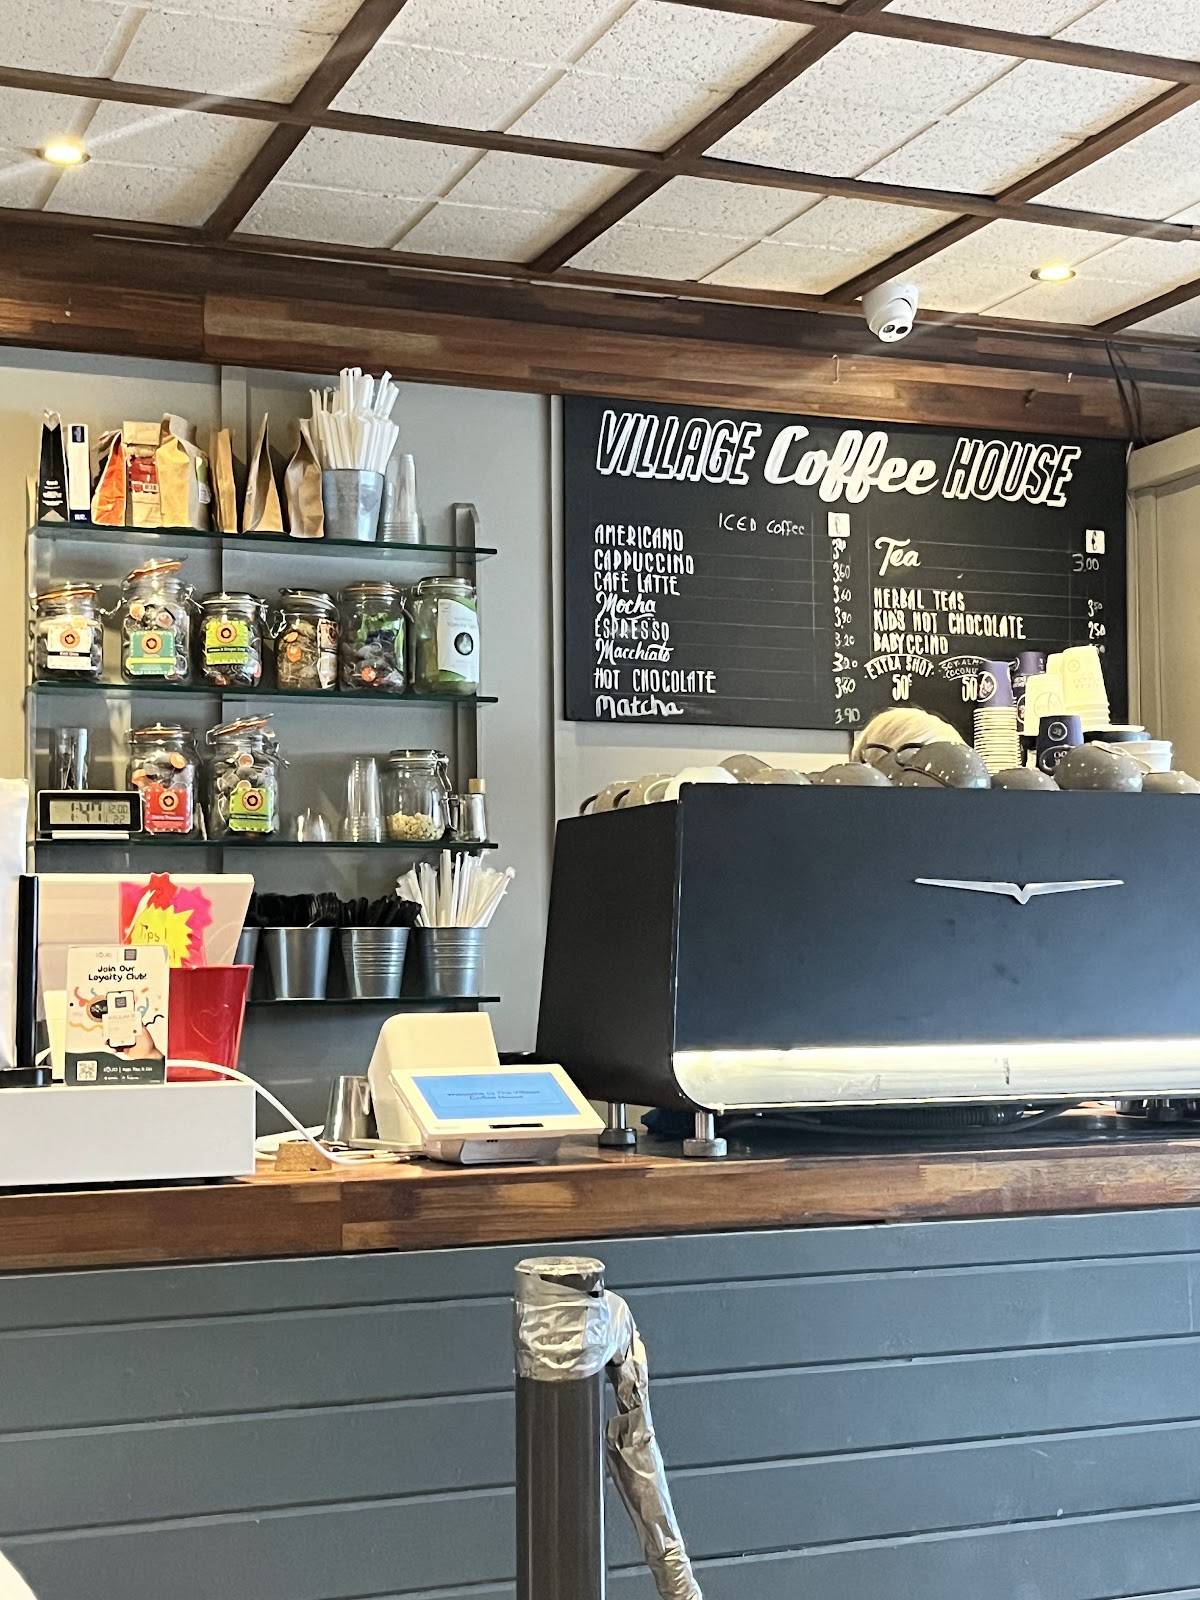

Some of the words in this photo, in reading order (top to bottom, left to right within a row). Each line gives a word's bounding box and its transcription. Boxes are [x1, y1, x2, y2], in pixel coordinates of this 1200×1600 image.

[596, 410, 762, 485] VILLAGE
[763, 426, 939, 503] Coffee
[942, 437, 1081, 507] HOUSE
[719, 512, 757, 532] ICED
[594, 523, 684, 551] AMERICANO
[594, 548, 695, 575] CAPPUCCINO
[874, 536, 921, 576] Tea
[637, 572, 680, 596] LATTE
[595, 591, 656, 621] Mocha
[873, 587, 924, 610] HERBAL
[932, 590, 966, 612] TEAS
[594, 617, 670, 641] ESPRESSO
[912, 611, 938, 634] HOT
[948, 612, 1027, 640] CHOCOLATE
[595, 637, 675, 665] Macchiato
[873, 631, 949, 655] BABYCCINO
[593, 667, 621, 690] HOT
[632, 668, 717, 693] CHOCOLATE
[865, 655, 901, 680] EXTRA
[905, 655, 934, 678] SHOT
[595, 694, 684, 719] Matcha
[88, 973, 123, 983] Loyalty
[97, 964, 116, 973] Join
